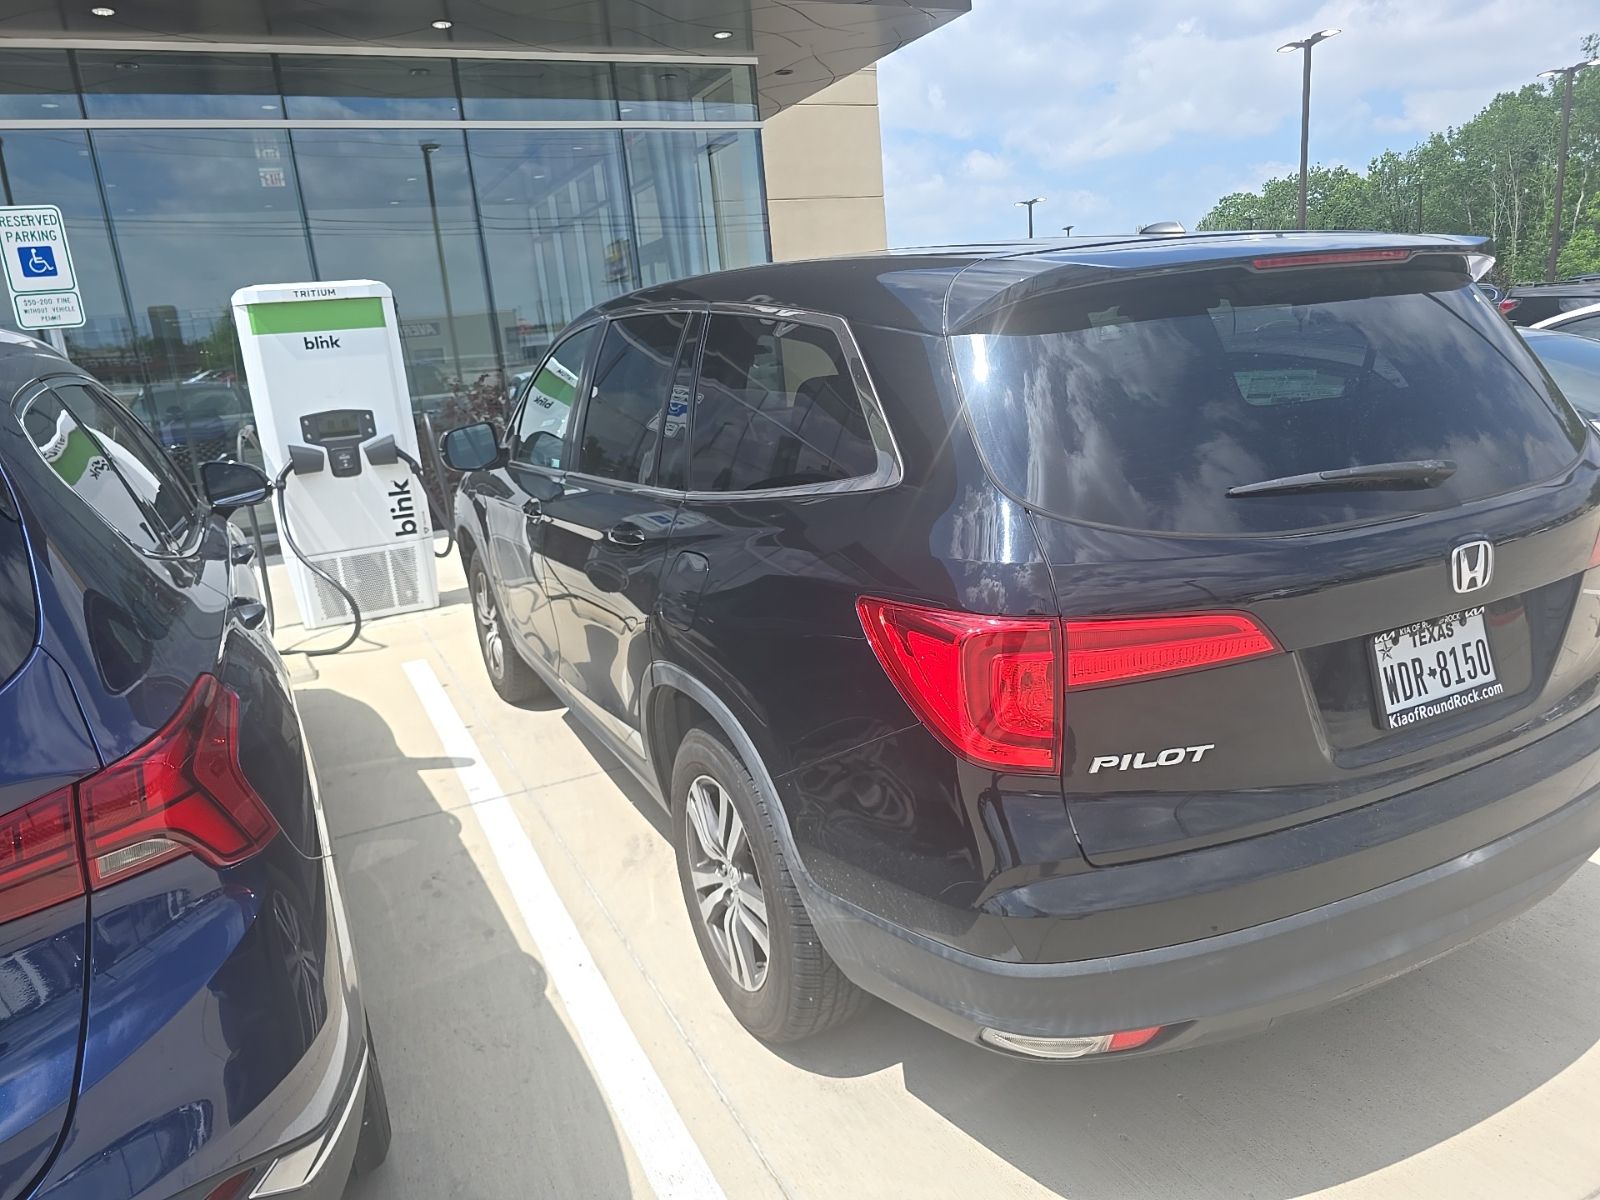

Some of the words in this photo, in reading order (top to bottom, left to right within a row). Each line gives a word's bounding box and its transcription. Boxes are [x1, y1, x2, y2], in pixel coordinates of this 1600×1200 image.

[0, 214, 58, 227] RESERVED
[5, 230, 57, 243] PARKING
[293, 288, 336, 298] TRITIUM
[303, 335, 341, 350] blink
[388, 478, 418, 537] blink
[1399, 626, 1411, 636] KIA
[1411, 622, 1421, 632] OF
[1409, 622, 1454, 648] TEXAS
[1388, 682, 1504, 729] KiaofRoundRock.com
[1088, 743, 1215, 774] PILOT
